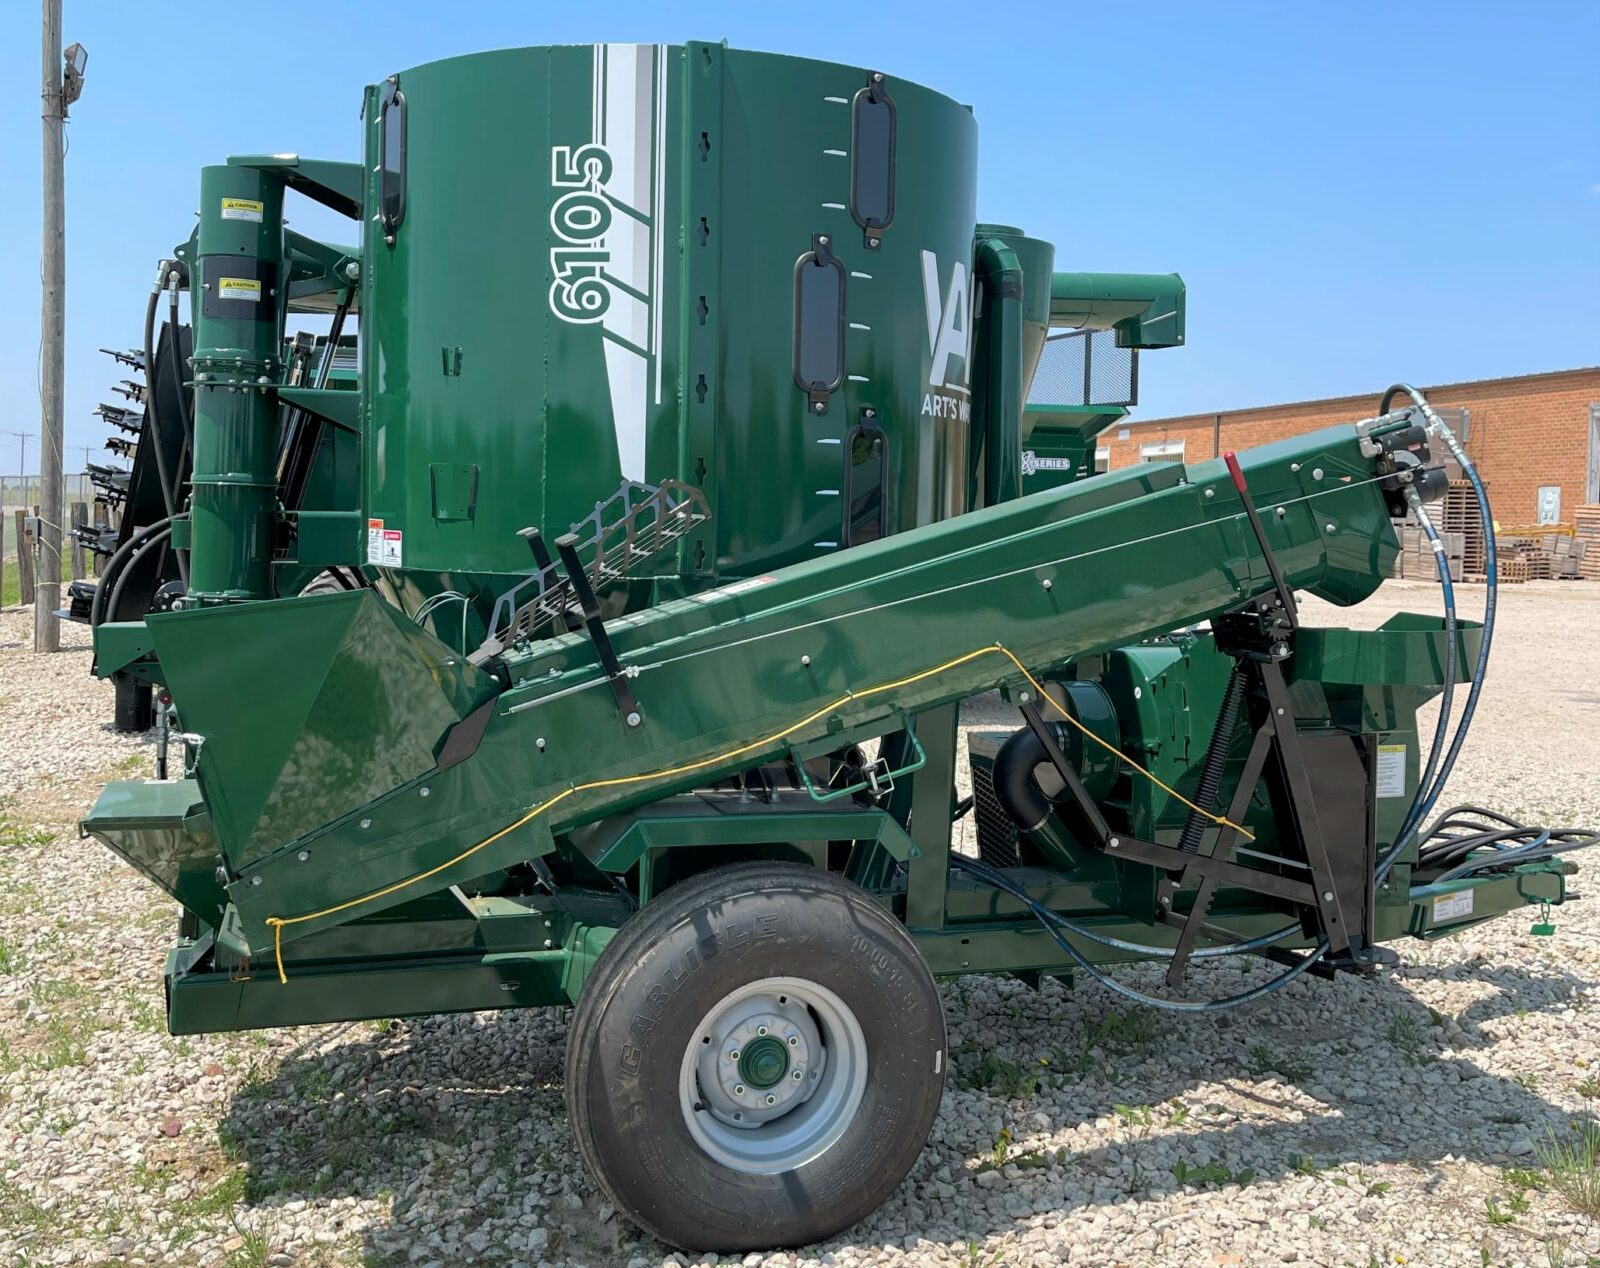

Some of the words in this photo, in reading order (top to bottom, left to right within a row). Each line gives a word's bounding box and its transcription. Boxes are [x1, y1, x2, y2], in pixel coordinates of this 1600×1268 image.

[549, 143, 613, 324] 6105
[921, 393, 958, 420] ART'S
[958, 400, 971, 424] WA
[1033, 459, 1068, 468] SERIES
[618, 913, 778, 1077] CARLISLE
